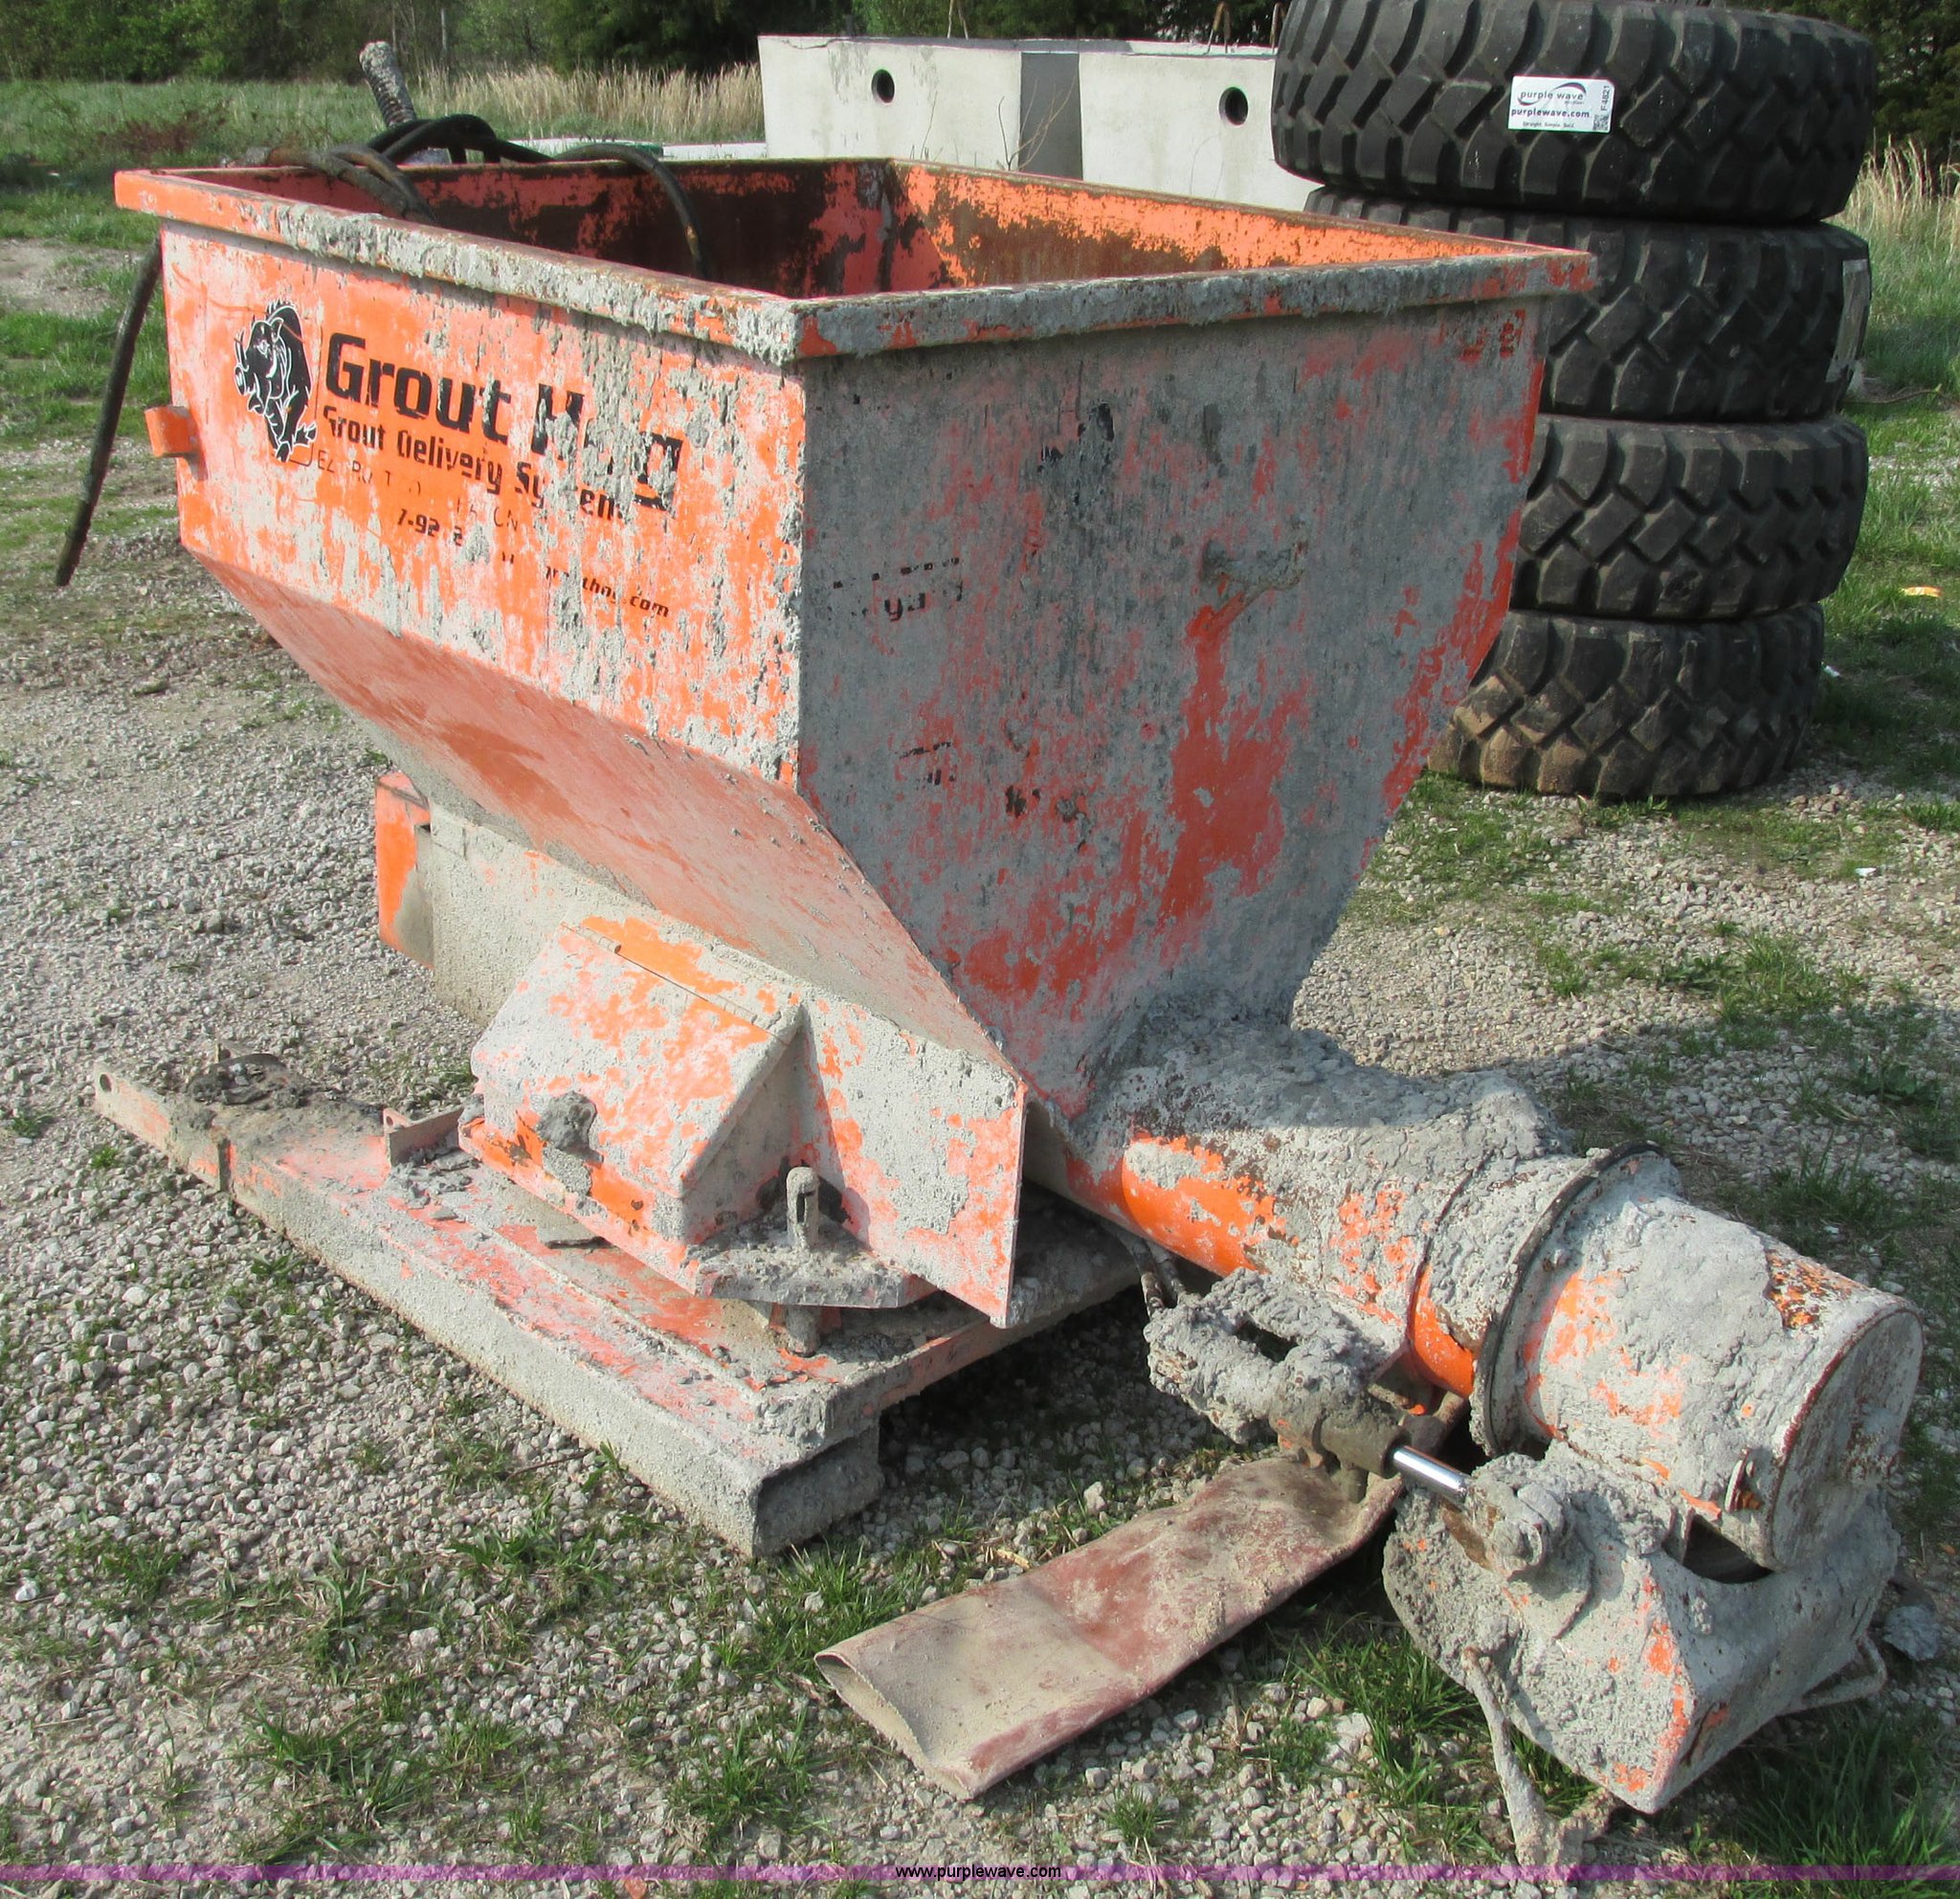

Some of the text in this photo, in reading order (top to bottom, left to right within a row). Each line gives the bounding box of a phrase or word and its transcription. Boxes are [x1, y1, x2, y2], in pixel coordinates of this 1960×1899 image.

[1511, 107, 1590, 119] purplewave.com
[1520, 90, 1553, 101] purple
[325, 332, 512, 446] Grout
[323, 405, 386, 451] Grout
[397, 430, 502, 496] Delivery
